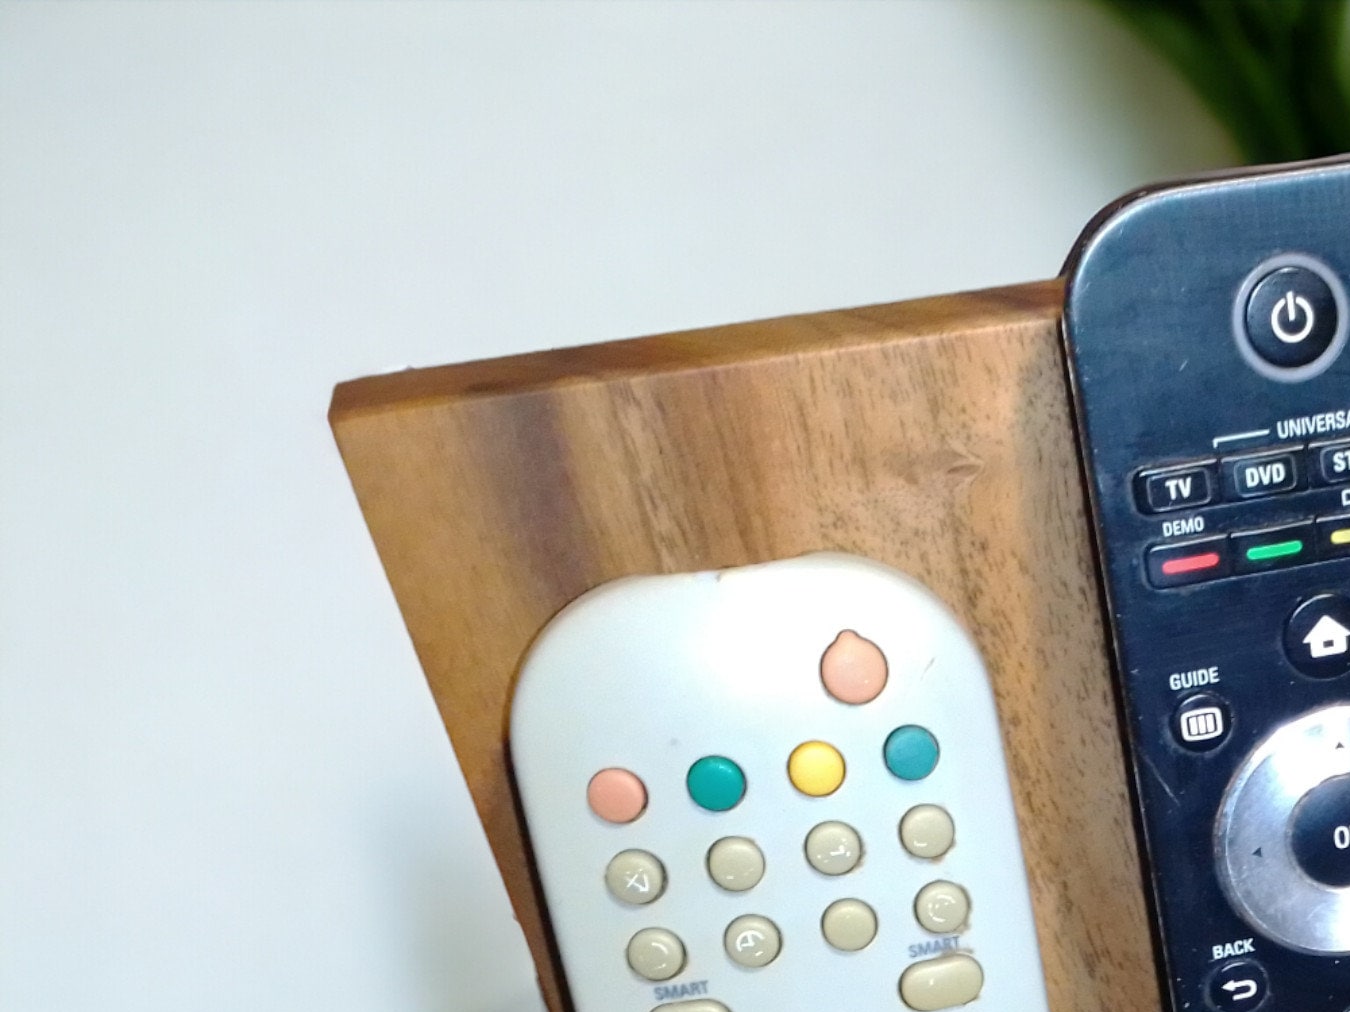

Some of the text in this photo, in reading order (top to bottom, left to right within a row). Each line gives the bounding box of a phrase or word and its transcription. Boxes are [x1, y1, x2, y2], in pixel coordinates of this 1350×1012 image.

[1245, 463, 1286, 488] DVD
[1165, 478, 1192, 500] TV
[1162, 517, 1205, 537] DEMO
[1169, 666, 1220, 691] GUIDE
[908, 935, 961, 958] SMART
[1212, 938, 1256, 961] BACK
[654, 980, 709, 1001] SMART
